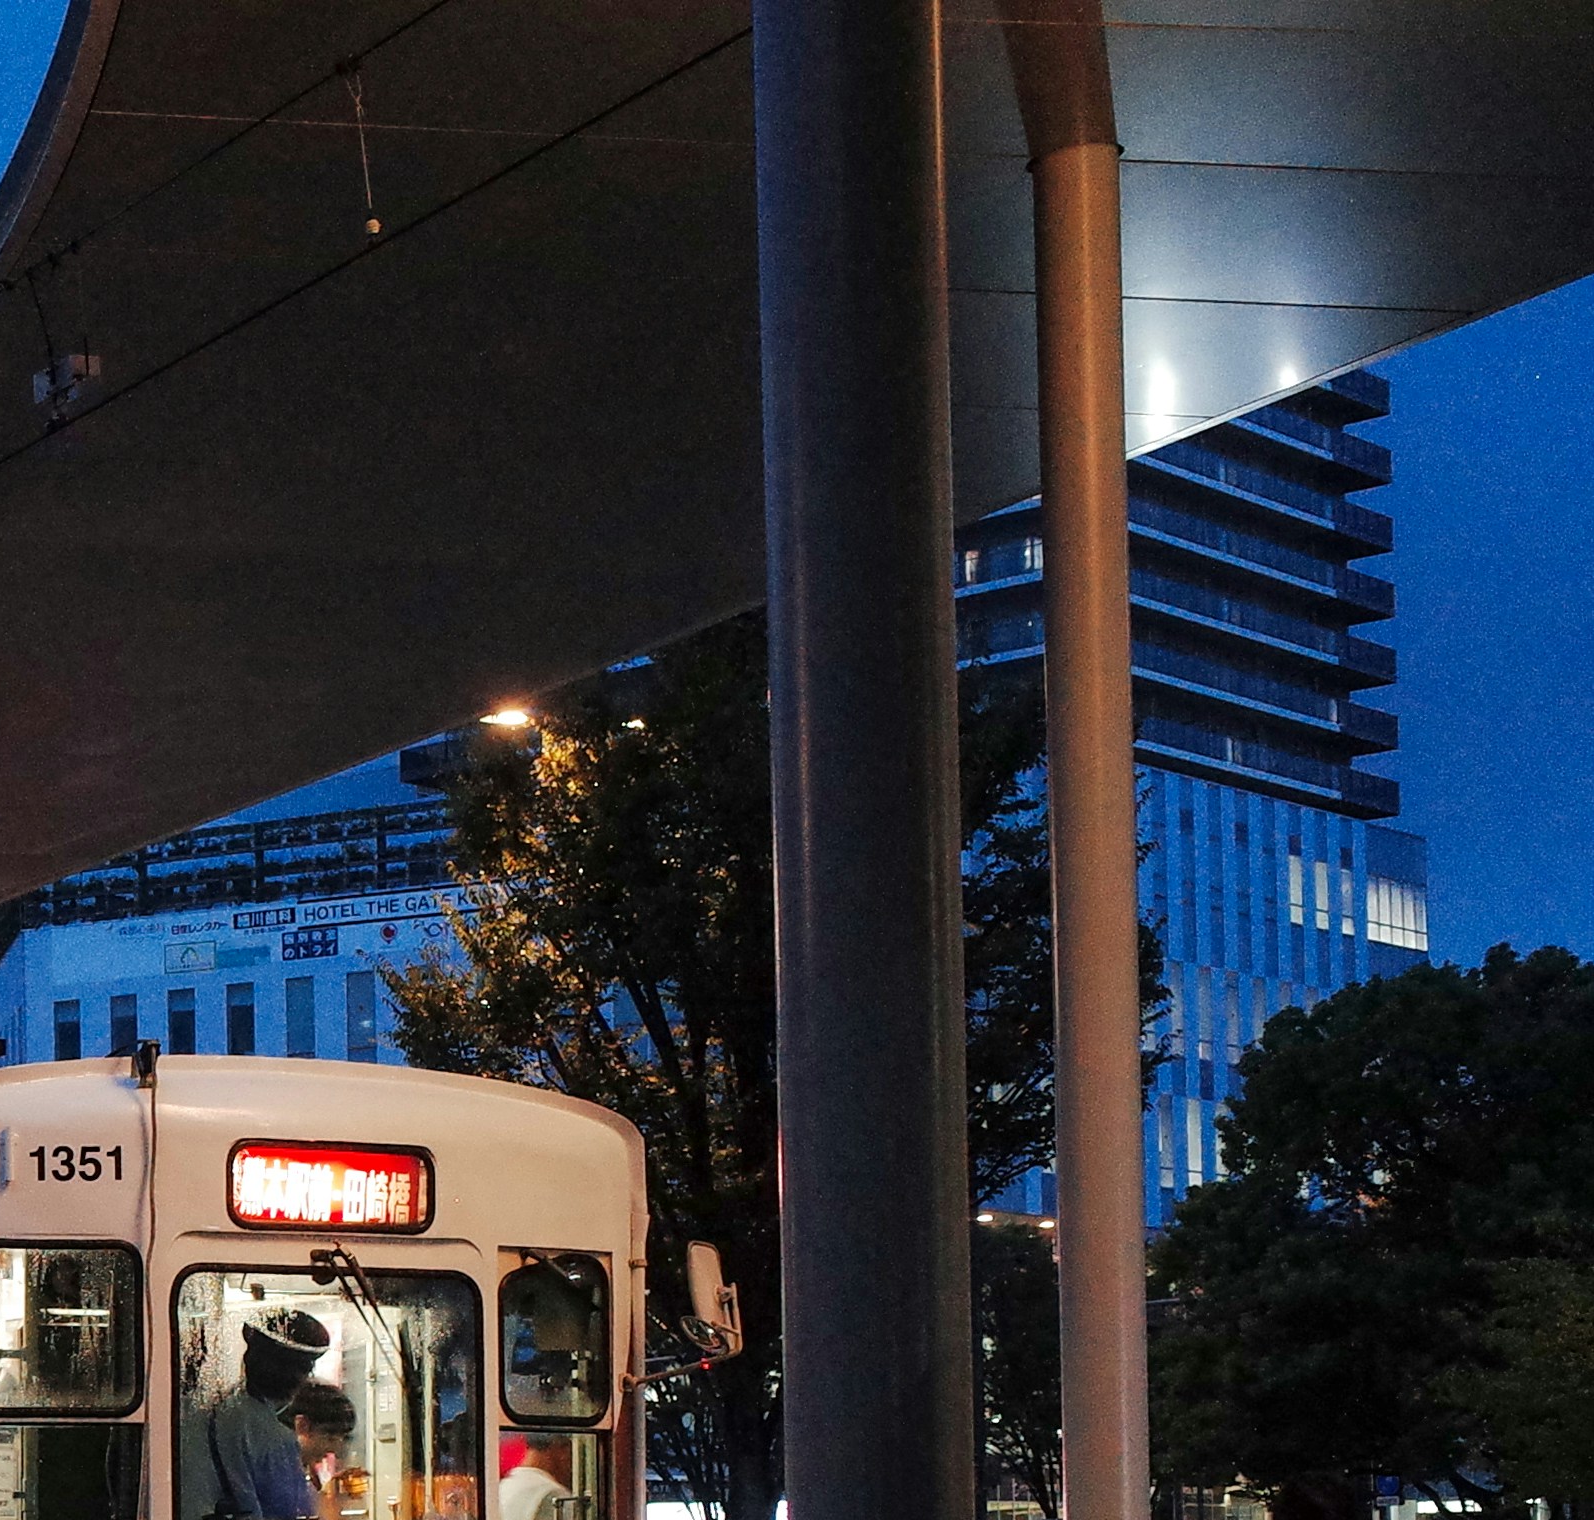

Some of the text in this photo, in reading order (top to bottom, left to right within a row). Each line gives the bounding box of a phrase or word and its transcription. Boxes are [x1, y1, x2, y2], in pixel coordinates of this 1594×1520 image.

[304, 904, 361, 922] HOTEL
[365, 898, 400, 915] THE
[284, 944, 336, 958] のトライ
[28, 1145, 125, 1181] 1351
